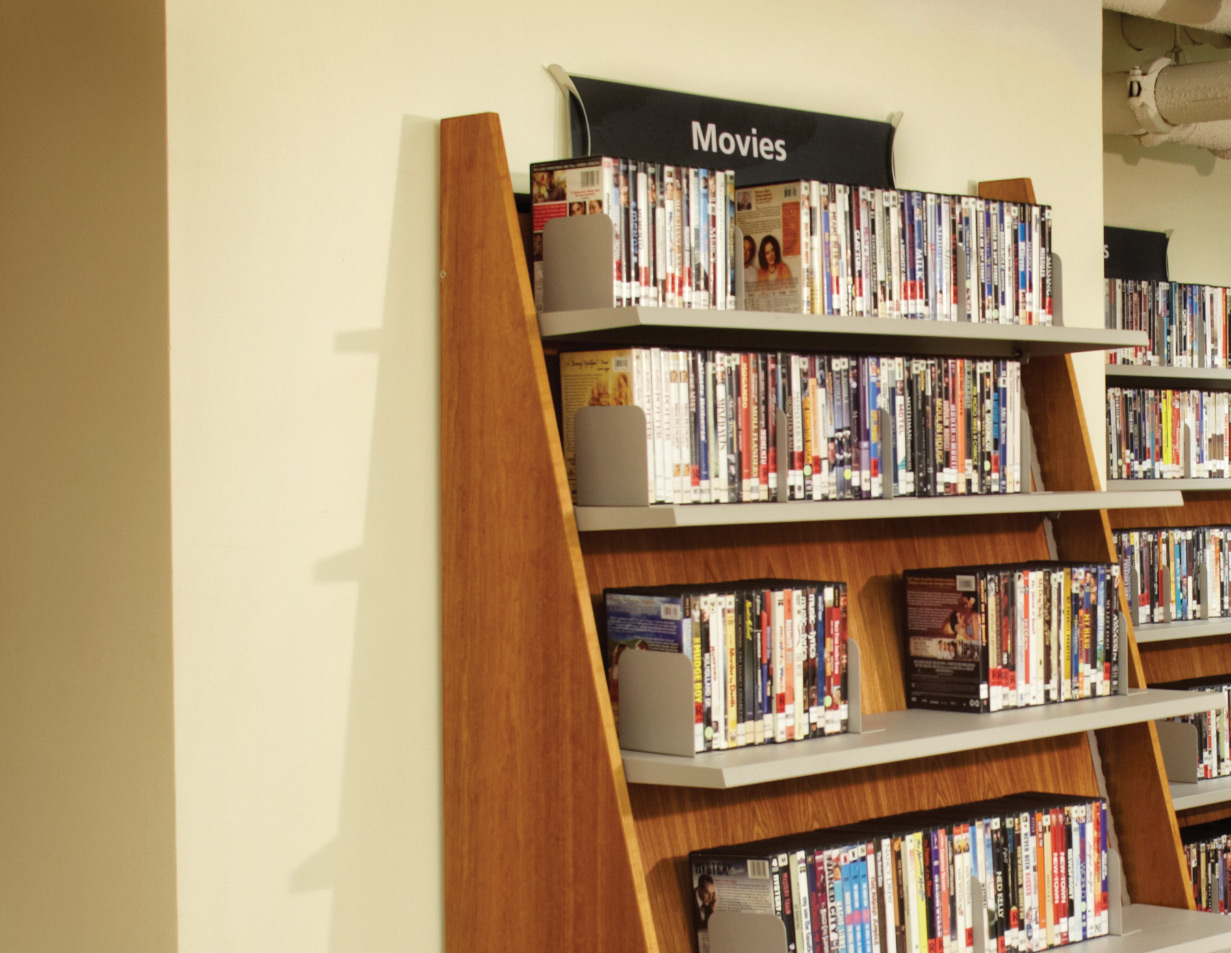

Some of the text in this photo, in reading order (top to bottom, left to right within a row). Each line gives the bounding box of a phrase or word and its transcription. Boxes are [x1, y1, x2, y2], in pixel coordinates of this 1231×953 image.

[691, 121, 788, 163] Movies
[808, 594, 817, 658] music lyrics
[1084, 614, 1090, 625] MY
[694, 644, 703, 703] MUDGE BOY
[884, 844, 892, 873] NANCY
[773, 874, 782, 911] MYSTERY
[827, 857, 835, 903] NAKED
[803, 897, 807, 907] my
